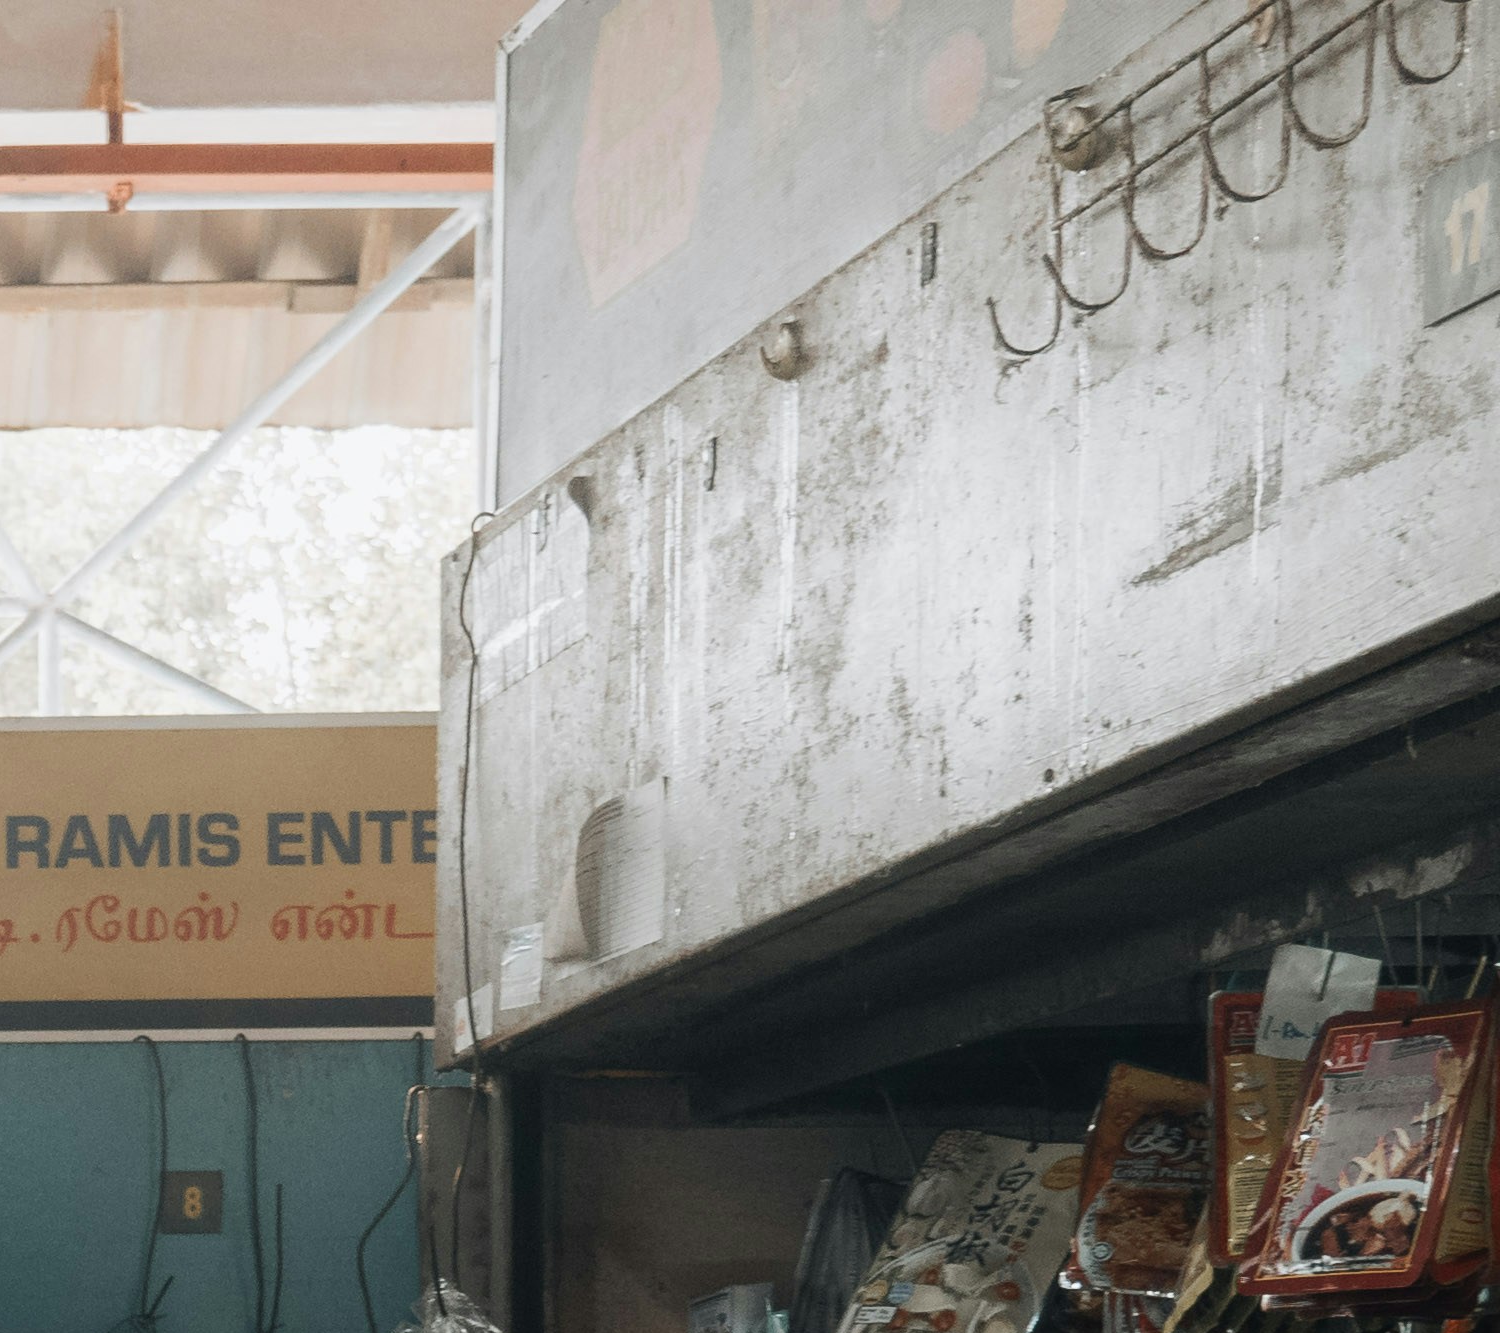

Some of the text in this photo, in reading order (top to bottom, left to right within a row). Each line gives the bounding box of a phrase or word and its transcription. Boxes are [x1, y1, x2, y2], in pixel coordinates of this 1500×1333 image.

[1444, 180, 1492, 275] 17
[5, 812, 240, 870] RAMIS
[1331, 1034, 1378, 1066] A1
[184, 1185, 202, 1219] 8
